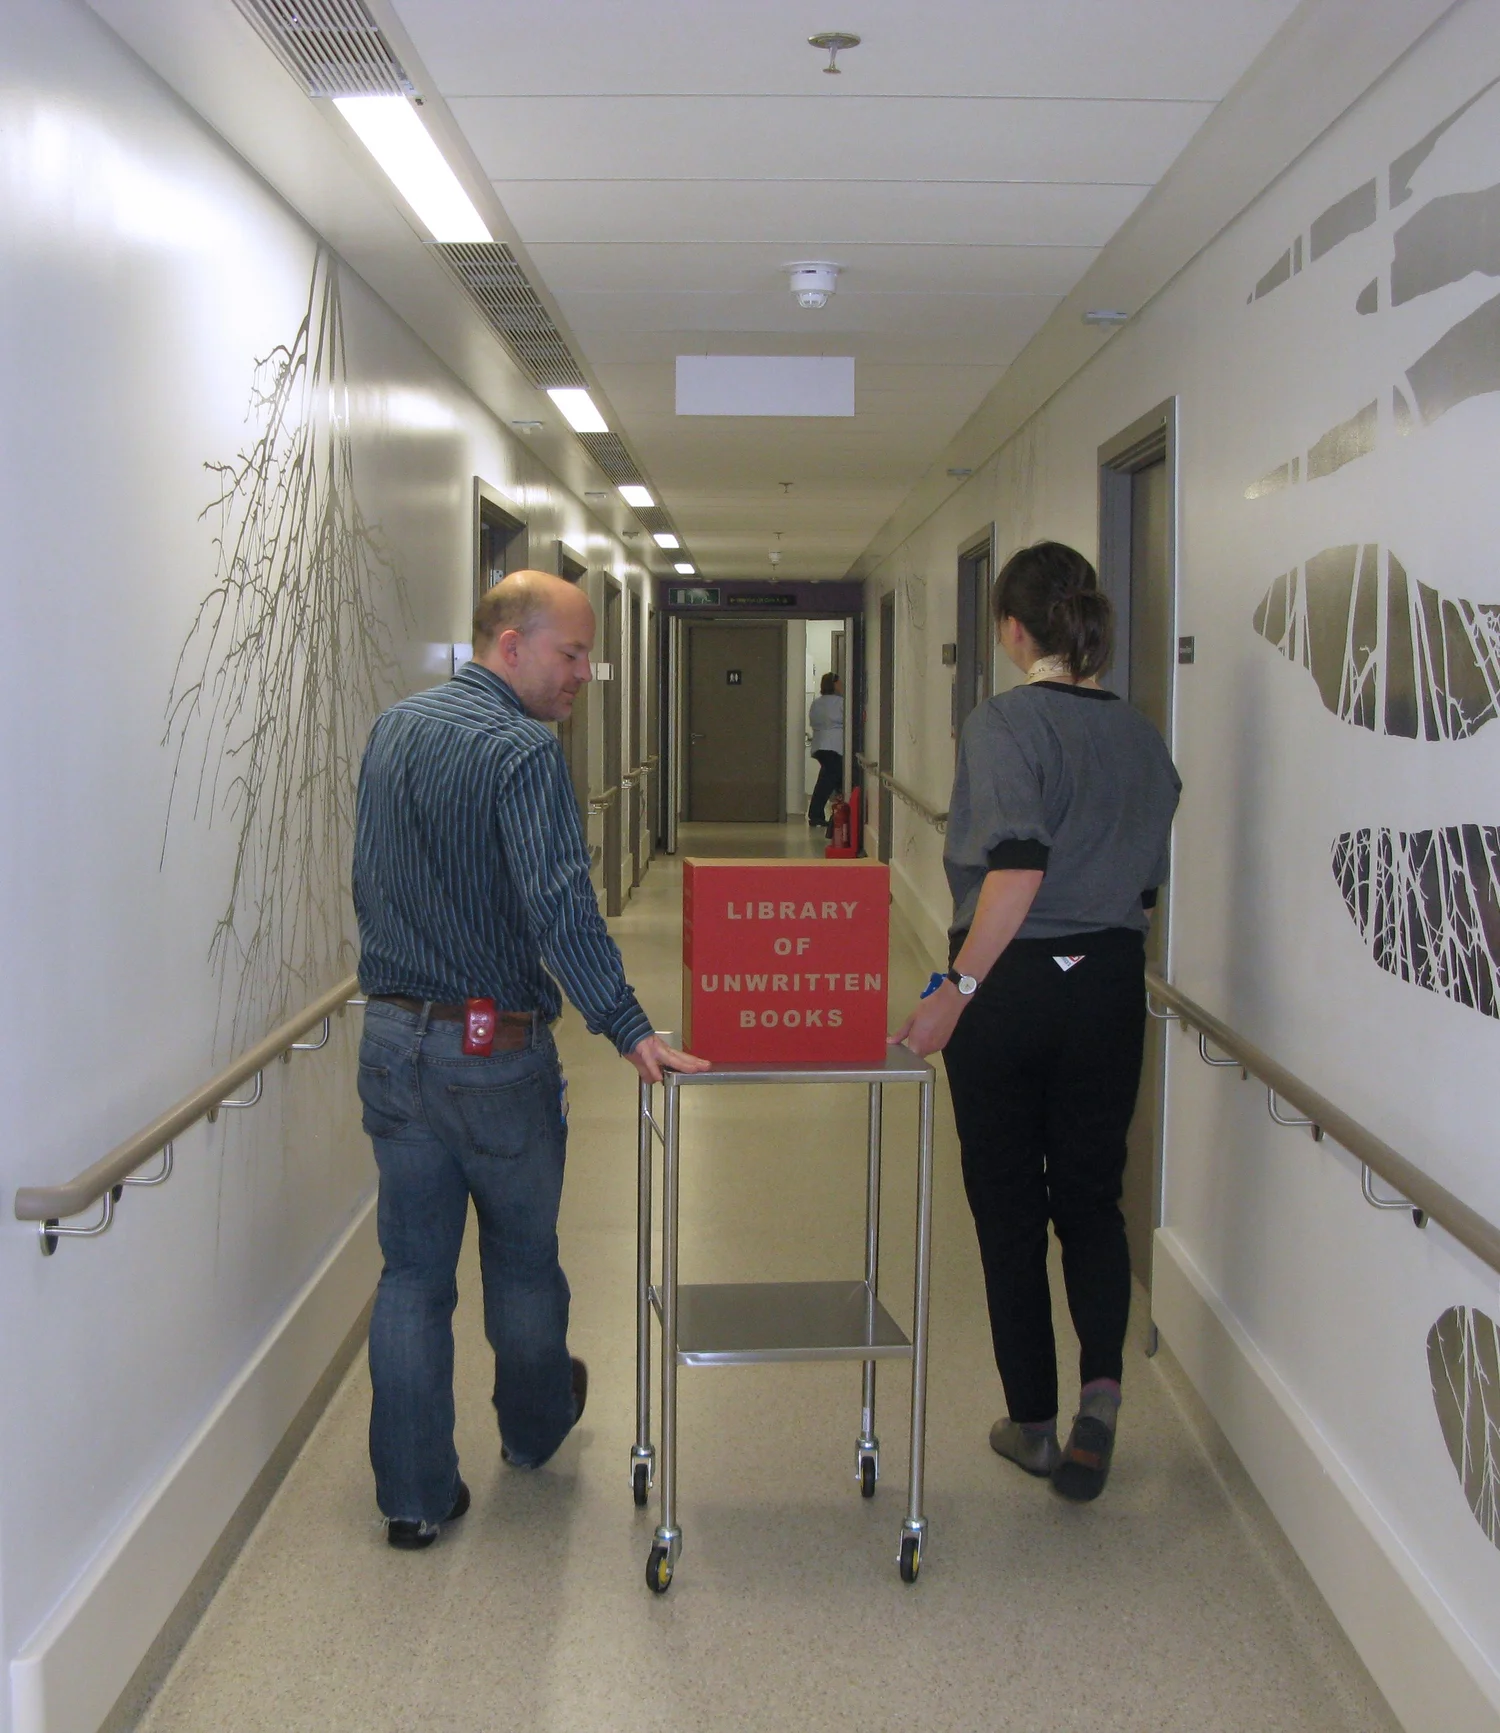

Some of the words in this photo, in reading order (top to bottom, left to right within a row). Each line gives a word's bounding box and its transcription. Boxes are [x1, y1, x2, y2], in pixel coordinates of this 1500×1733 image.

[727, 902, 858, 920] LIBRARY
[774, 938, 811, 955] OF
[701, 974, 882, 992] UNWRITTEN
[740, 1010, 843, 1028] BOOKS
